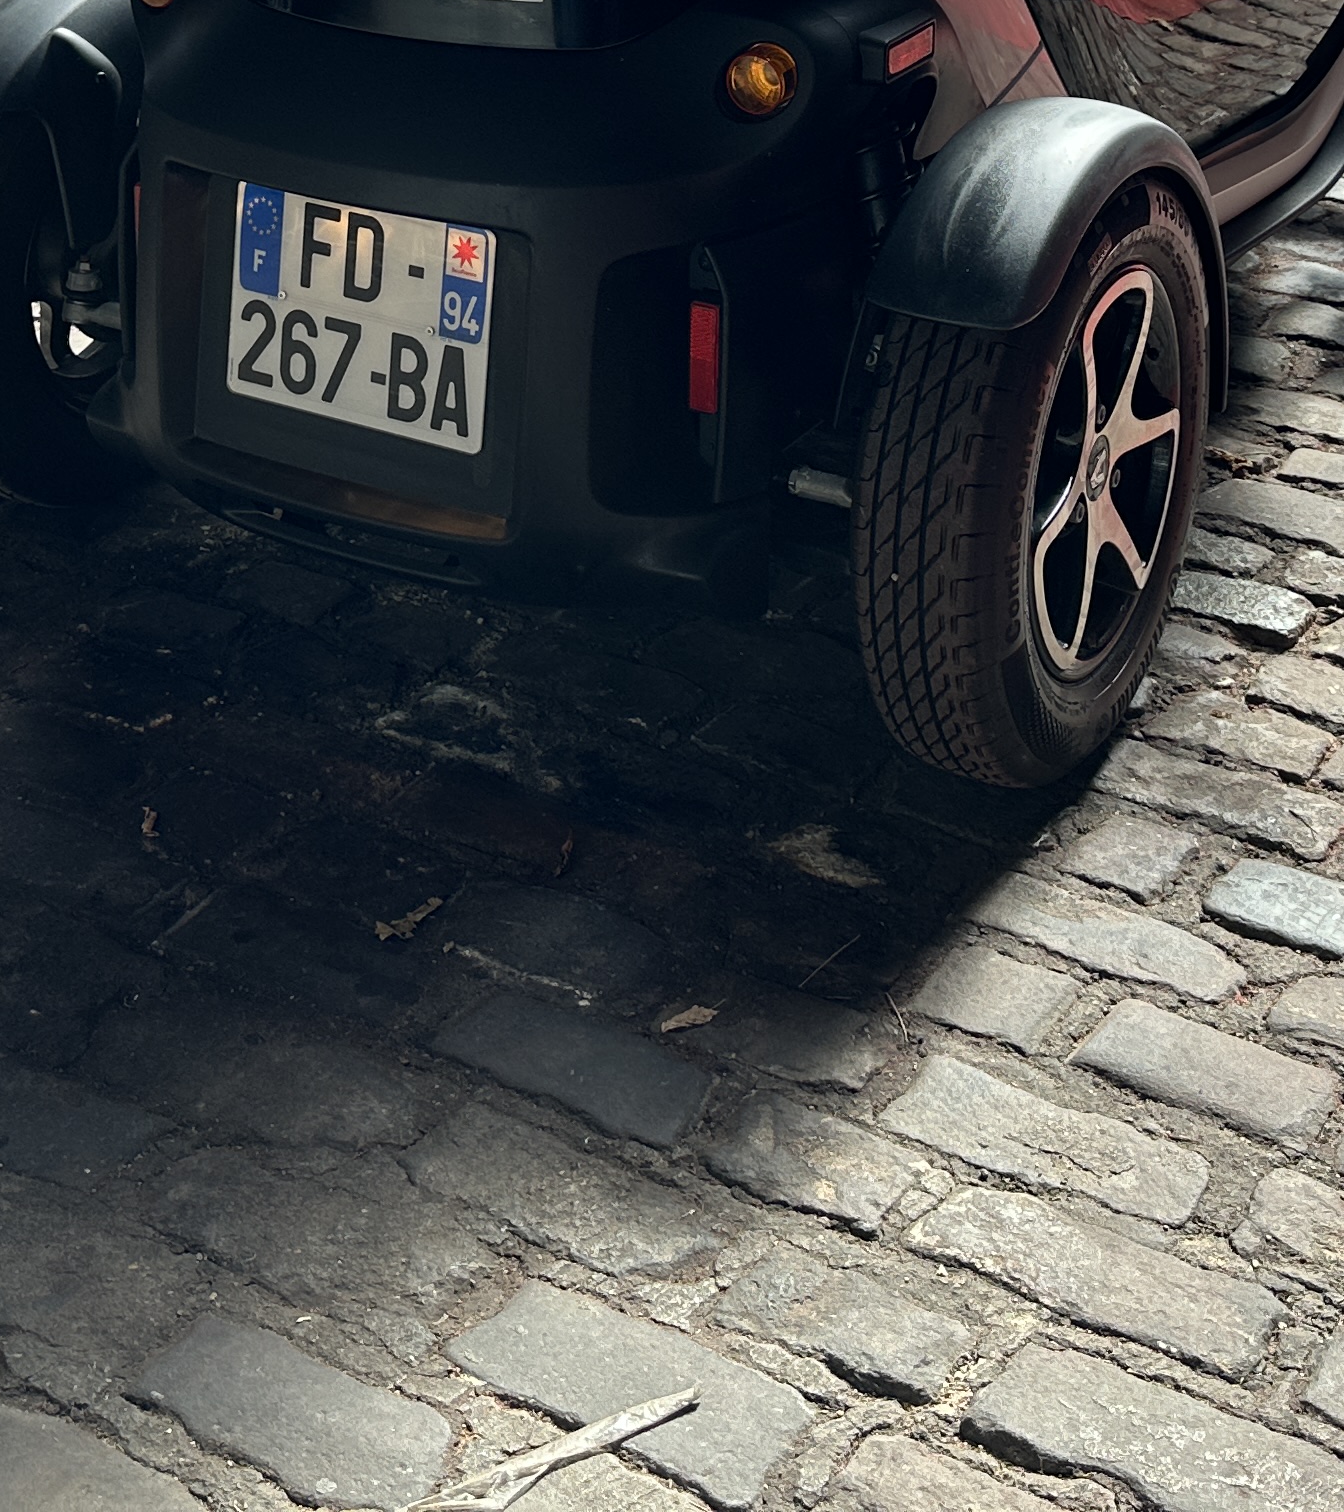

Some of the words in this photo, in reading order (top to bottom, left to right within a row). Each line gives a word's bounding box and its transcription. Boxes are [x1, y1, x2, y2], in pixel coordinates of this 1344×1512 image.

[253, 248, 266, 273] F
[443, 291, 479, 336] 94
[237, 299, 469, 438] 267-BA
